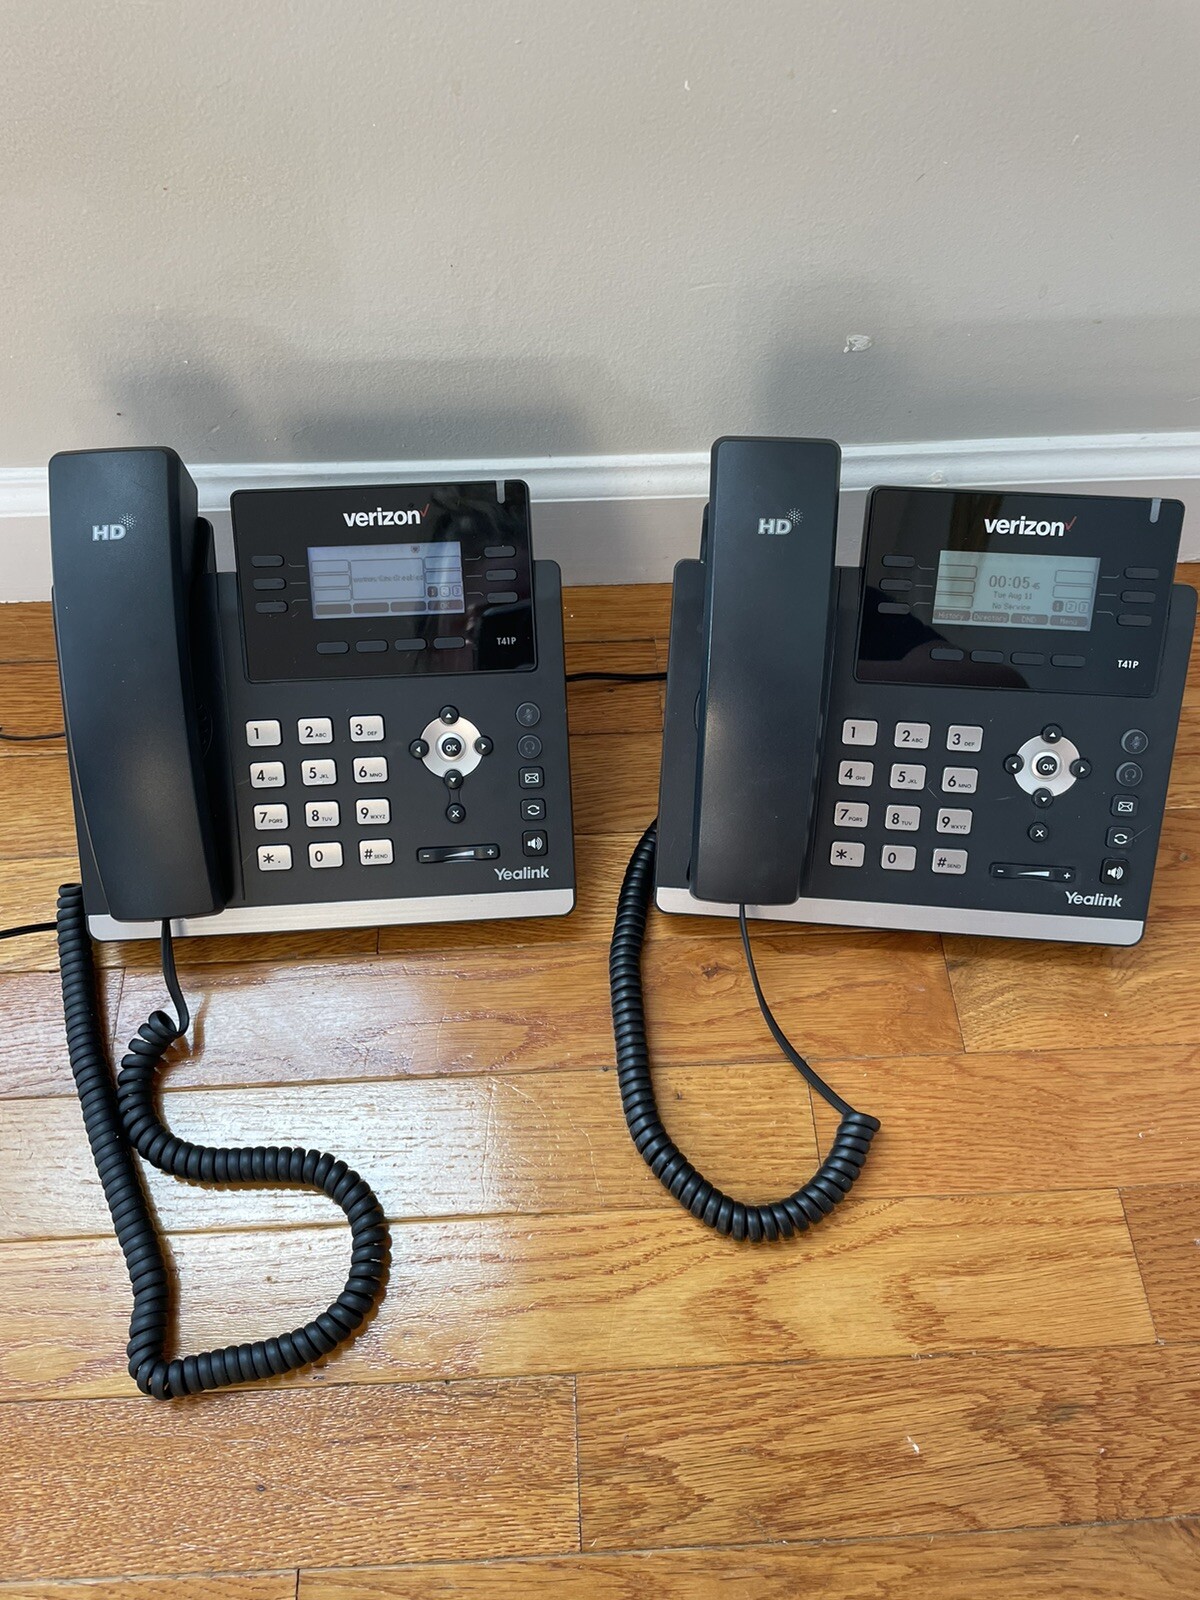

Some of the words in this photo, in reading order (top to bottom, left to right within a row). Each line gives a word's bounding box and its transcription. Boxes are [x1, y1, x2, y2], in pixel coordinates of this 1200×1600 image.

[343, 507, 421, 527] verizon
[92, 524, 126, 541] HD
[758, 518, 792, 535] HD
[984, 516, 1065, 537] verizon
[989, 575, 1031, 589] 00:05
[993, 591, 1006, 599] Tue
[1008, 592, 1022, 601] Aug
[938, 611, 964, 620] History
[973, 613, 1007, 623] Directory
[497, 637, 517, 646] T41P
[1117, 659, 1139, 669] T41P
[445, 744, 457, 752] OK
[494, 866, 550, 881] Yealink
[1065, 891, 1122, 907] Yealink
